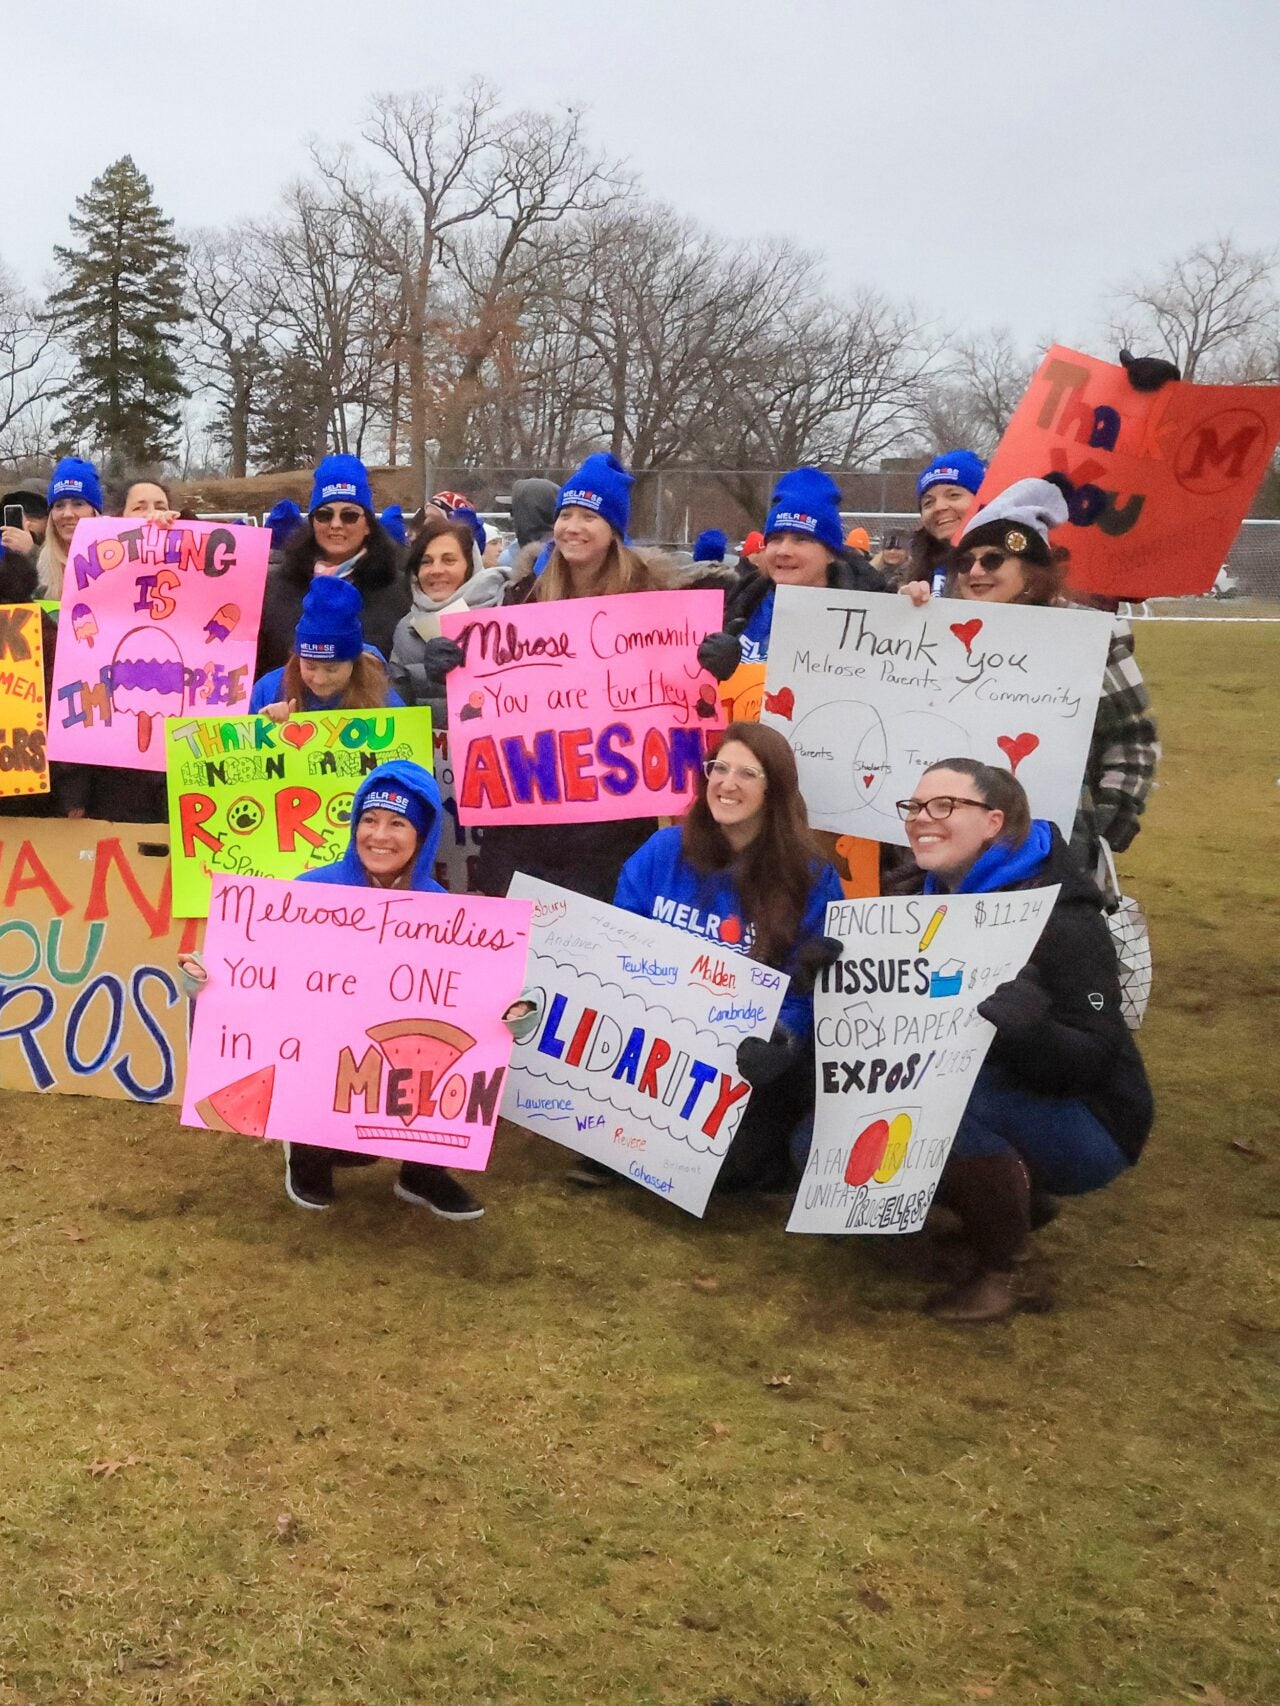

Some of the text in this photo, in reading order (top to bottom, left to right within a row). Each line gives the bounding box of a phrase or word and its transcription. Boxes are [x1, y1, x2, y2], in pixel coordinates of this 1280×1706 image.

[74, 525, 237, 590] NOTHING
[134, 570, 181, 620] IS
[455, 620, 577, 667] Melrose
[826, 607, 1029, 684] Thank you
[793, 651, 866, 678] Melrose
[879, 660, 942, 691] Parents
[484, 682, 528, 718] You
[547, 689, 588, 710] are
[171, 716, 395, 759] THANK YOU
[460, 722, 726, 809] AWESOM
[215, 885, 376, 942] Melrose
[826, 901, 921, 936] PENCILS
[223, 957, 463, 1008] You are ONE
[220, 1025, 301, 1062] in a
[817, 1010, 886, 1048] COPY
[894, 1008, 964, 1045] PAPER
[333, 1044, 506, 1127] MELON
[822, 1053, 921, 1094] EXPOS
[517, 1089, 574, 1111] Lawrence
[575, 1115, 606, 1131] WEA
[824, 1147, 848, 1175] FAI
